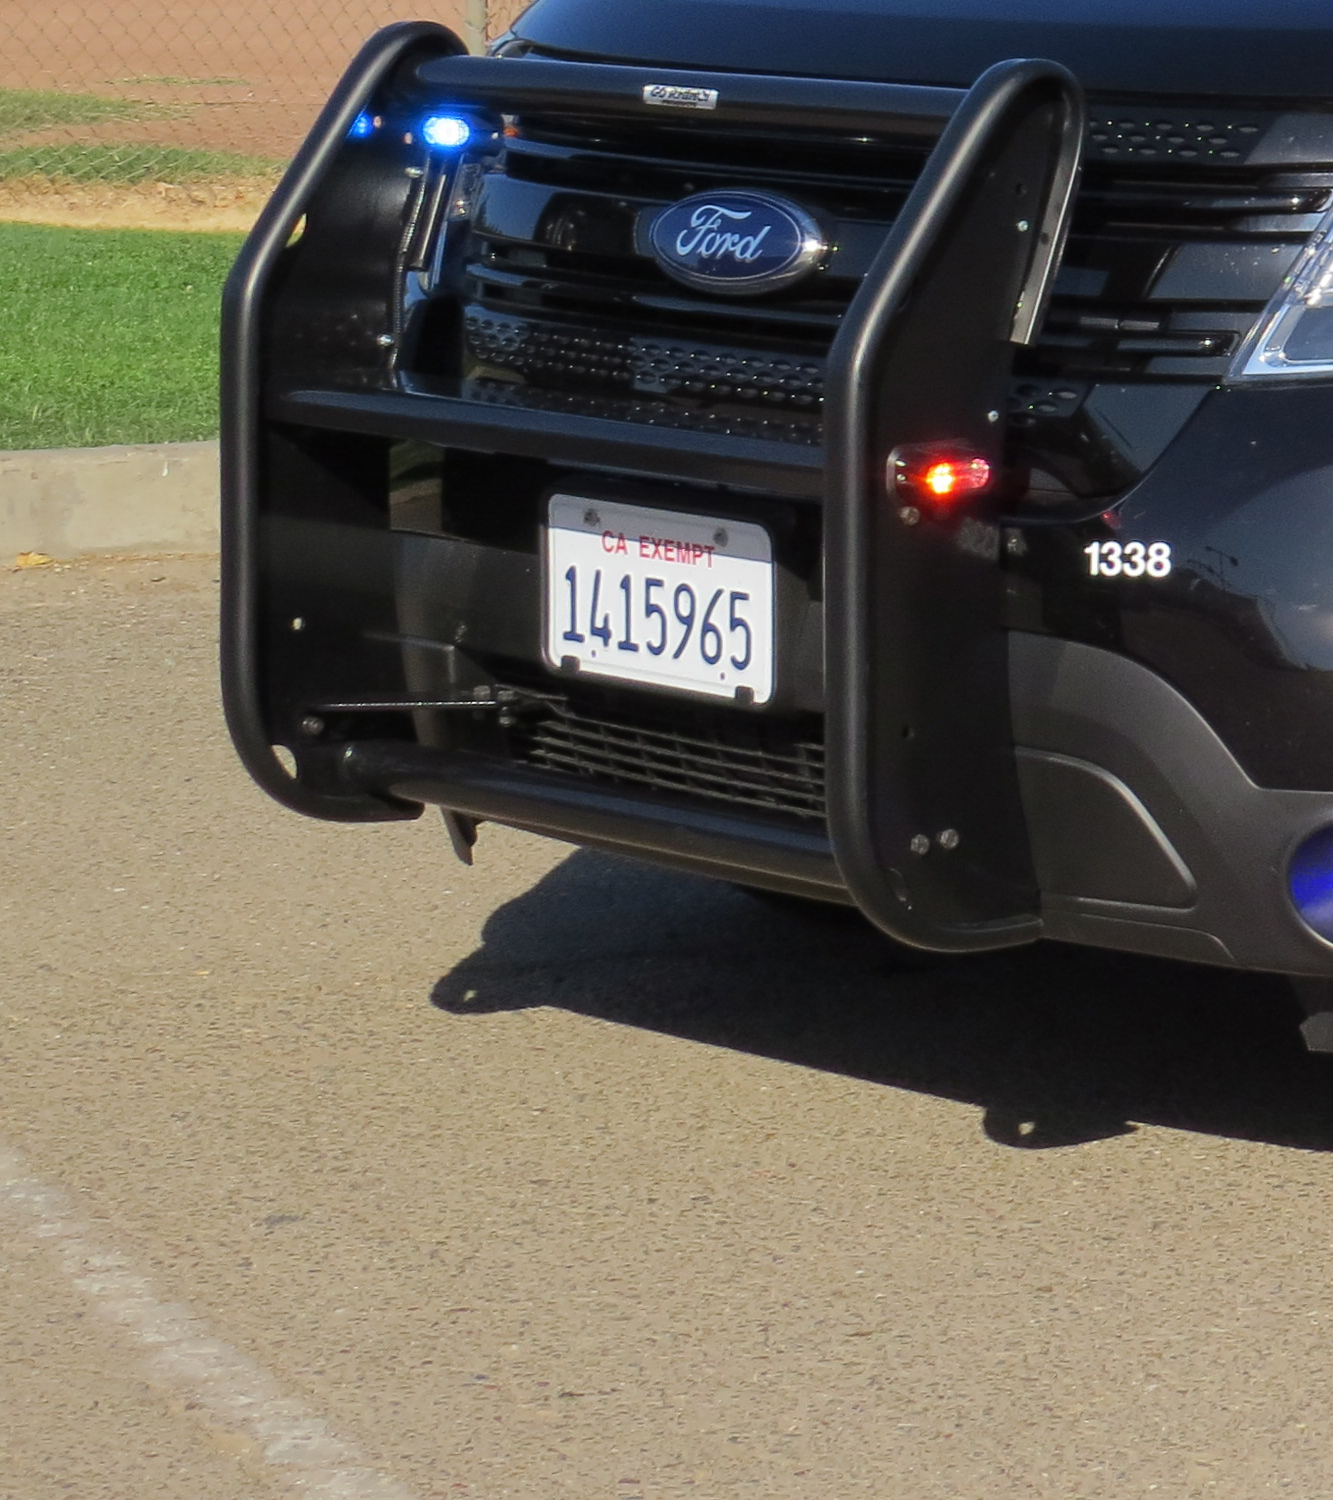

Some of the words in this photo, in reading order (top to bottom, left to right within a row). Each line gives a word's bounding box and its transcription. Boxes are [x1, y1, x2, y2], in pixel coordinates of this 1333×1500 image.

[675, 204, 773, 263] Ford
[600, 529, 628, 556] CA
[638, 535, 716, 568] EXEMPT
[1083, 540, 1172, 578] 1338
[562, 565, 752, 672] 1415965
